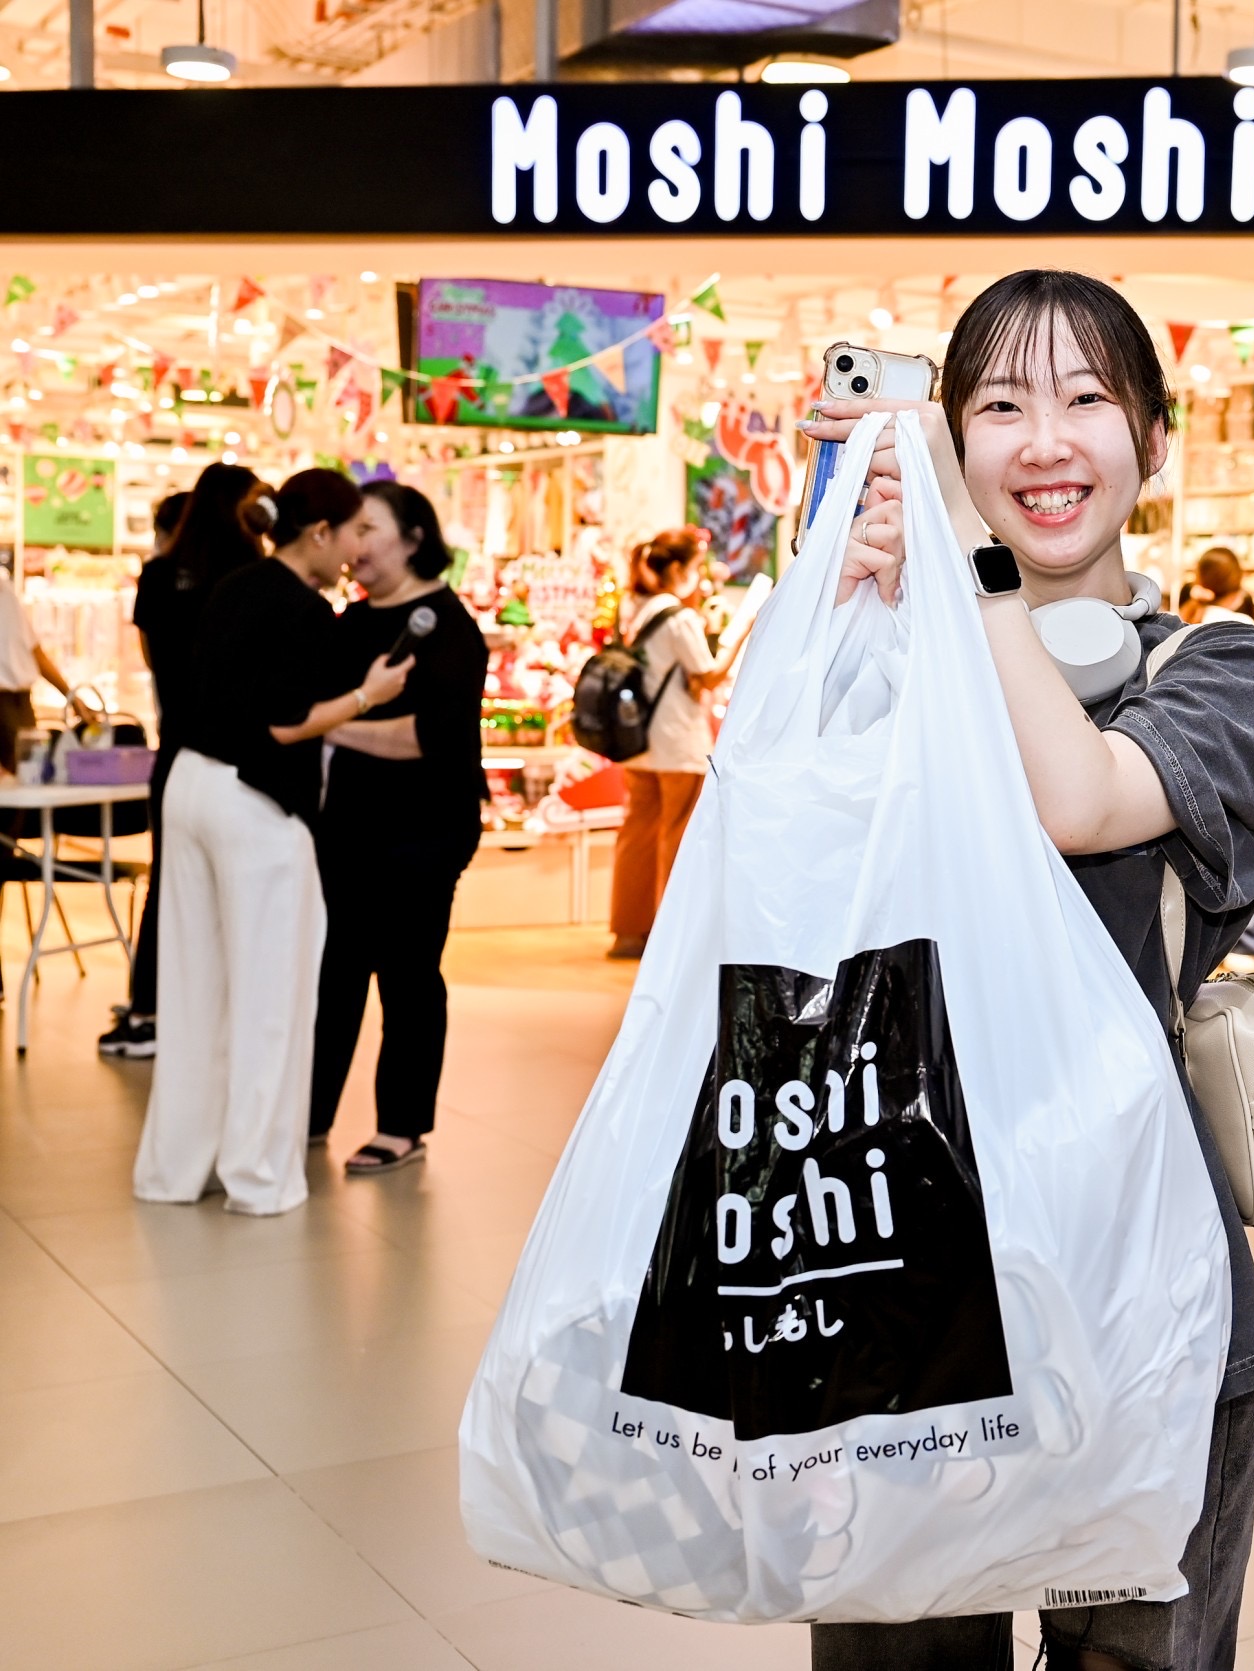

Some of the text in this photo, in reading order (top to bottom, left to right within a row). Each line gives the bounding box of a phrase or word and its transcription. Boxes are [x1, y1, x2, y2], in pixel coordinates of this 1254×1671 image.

[491, 88, 829, 225] Moshi
[611, 1412, 645, 1438] Let
[655, 1430, 681, 1449] us
[692, 1432, 723, 1461] be
[752, 1454, 777, 1481] of
[788, 1445, 843, 1482] your
[855, 1425, 969, 1462] everyday
[981, 1414, 1020, 1442] life
